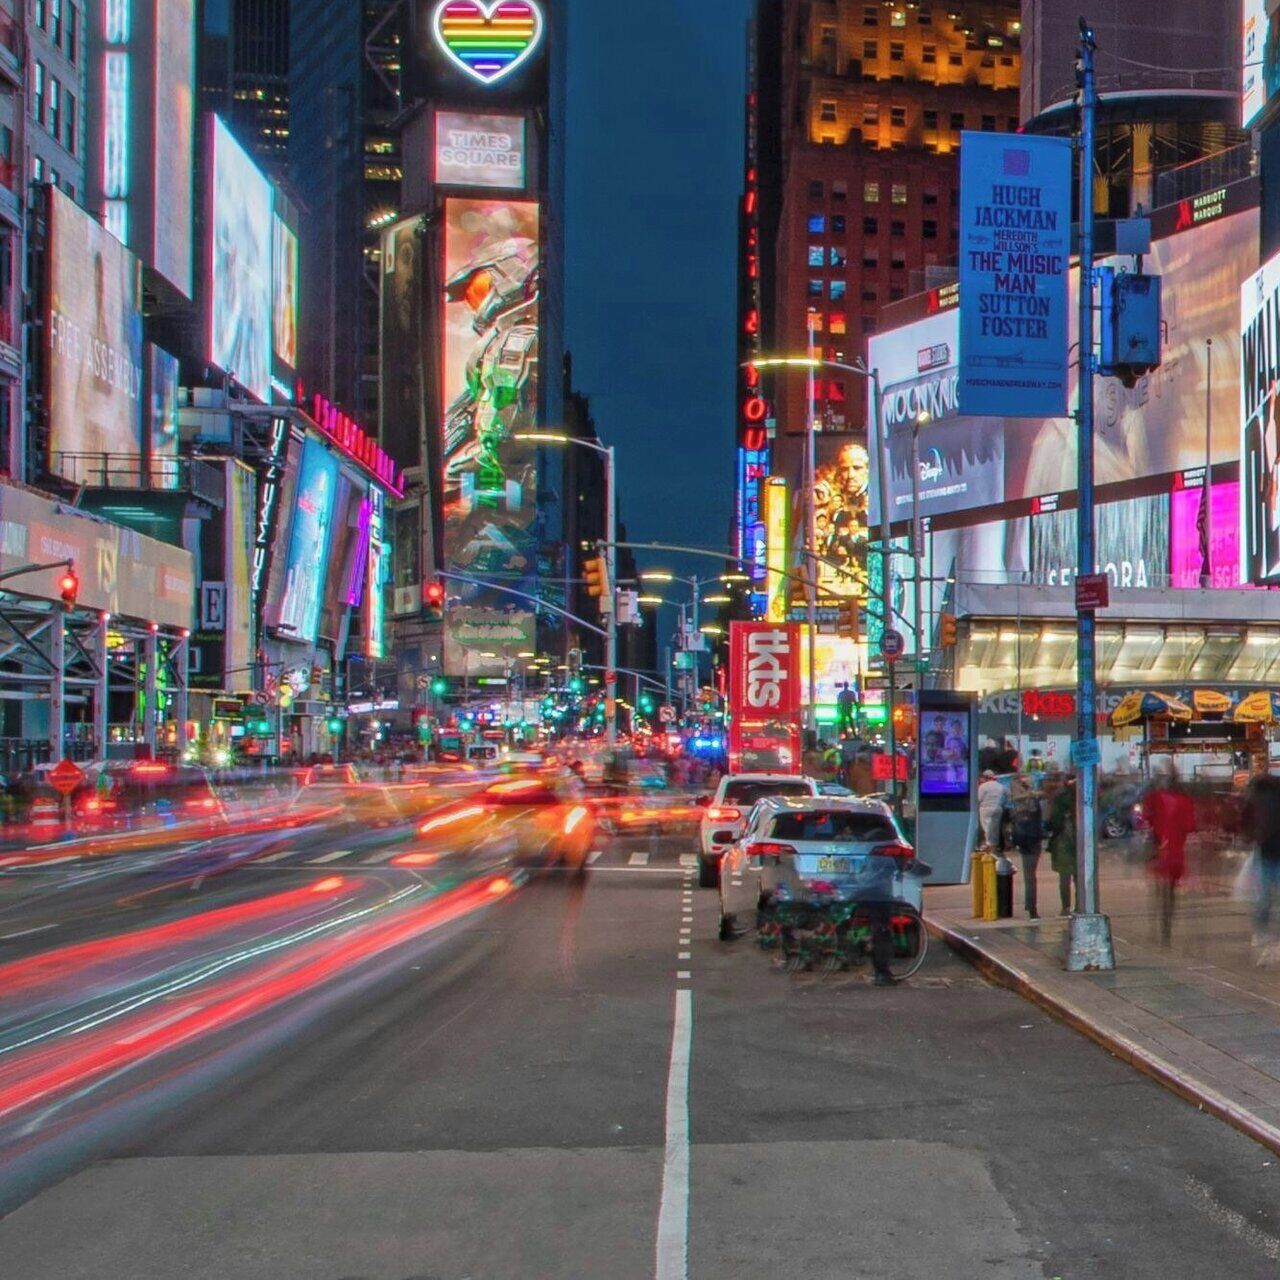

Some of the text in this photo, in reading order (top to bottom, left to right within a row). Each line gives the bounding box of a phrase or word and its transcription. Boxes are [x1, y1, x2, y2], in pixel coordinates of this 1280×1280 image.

[450, 131, 511, 151] TIMES
[442, 149, 519, 168] SQUARE
[992, 185, 1041, 207] HUGH
[1193, 189, 1226, 207] MARRIOTT
[974, 207, 1058, 231] JACKMAN
[1193, 203, 1223, 221] MARQUIS
[993, 229, 1038, 242] MEREDITH
[968, 251, 1062, 275] THE MUSIC
[994, 274, 1036, 294] MAN
[979, 293, 1050, 317] SUTTON
[981, 316, 1048, 339] FOSTER
[257, 483, 275, 543] MAC
[1047, 558, 1149, 588] SEORA
[747, 628, 790, 708] tkts
[979, 691, 1020, 714] kts
[1022, 689, 1074, 716] tkts
